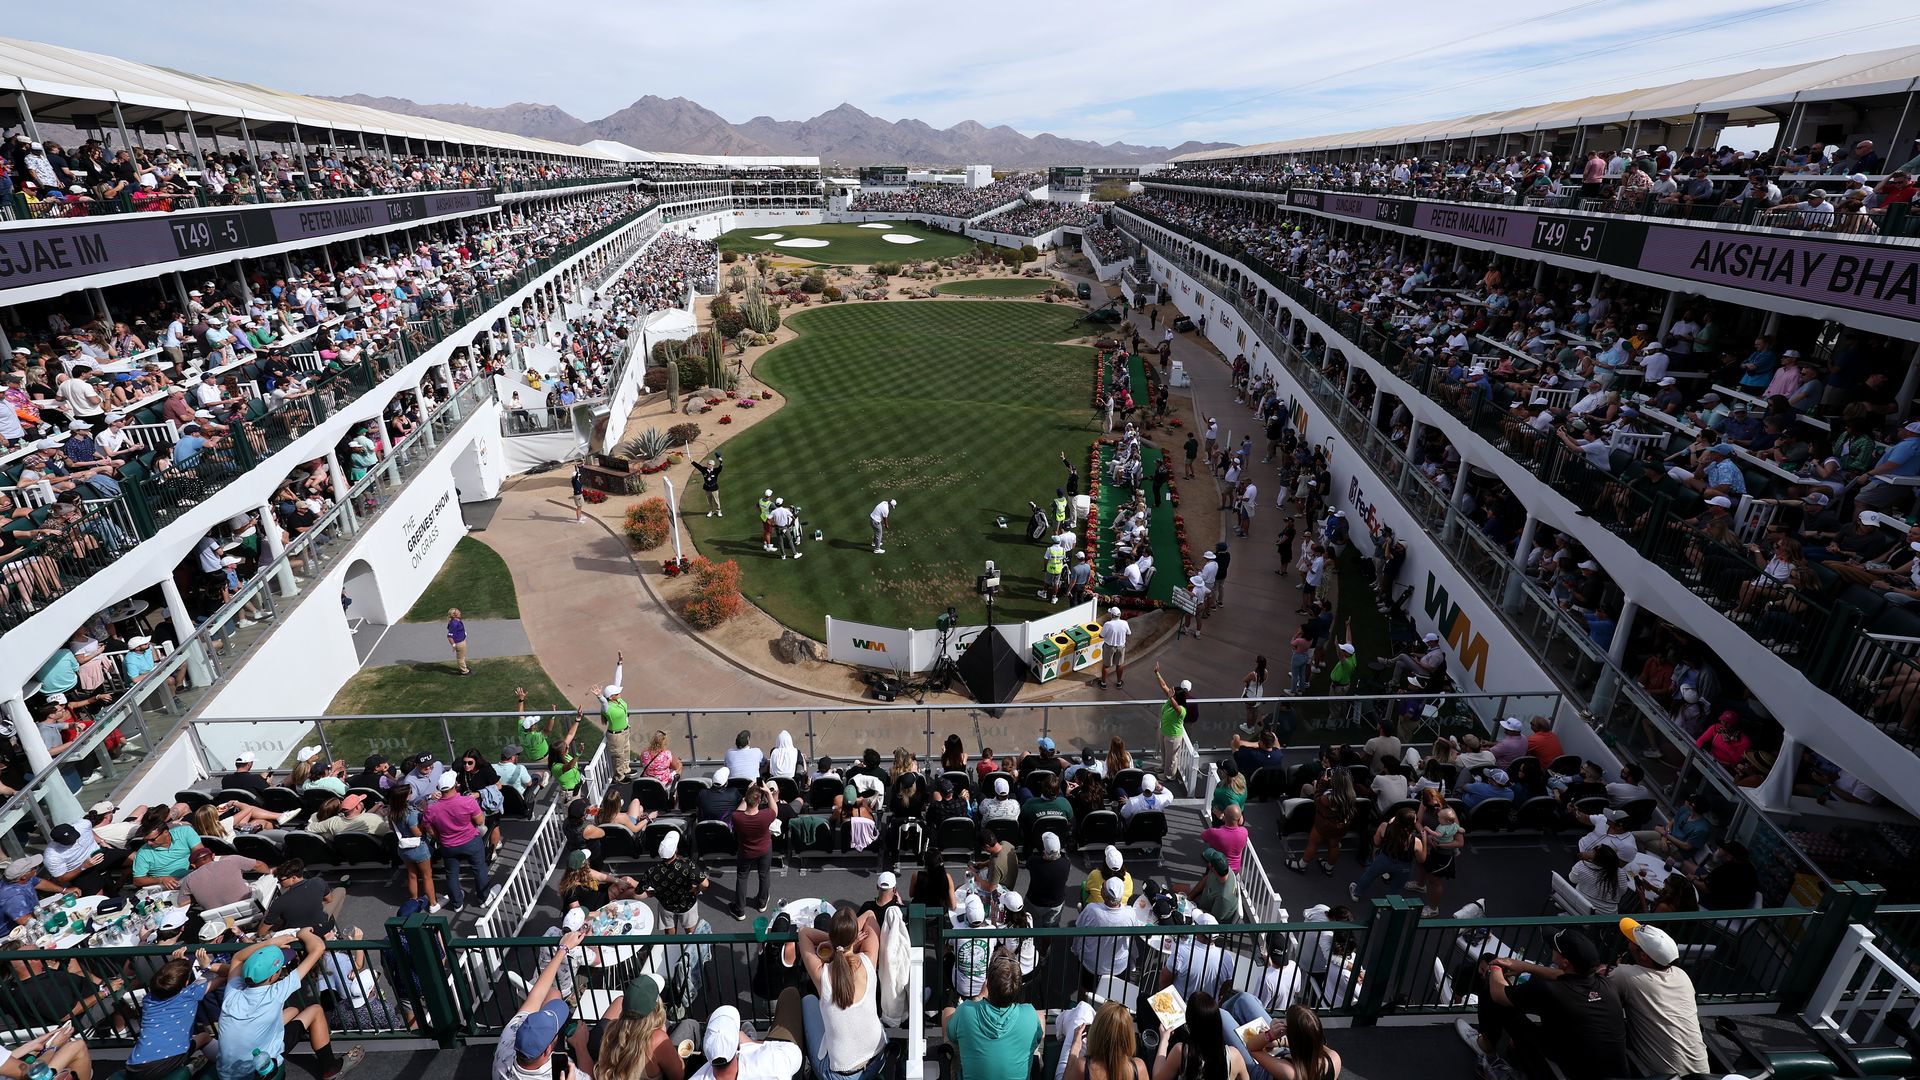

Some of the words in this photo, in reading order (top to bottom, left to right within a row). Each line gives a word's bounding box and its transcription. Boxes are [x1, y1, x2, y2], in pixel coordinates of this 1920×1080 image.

[299, 210, 334, 232] PETER
[333, 206, 374, 228] MALNATI
[387, 203, 402, 220] T49
[405, 201, 413, 217] -5
[1377, 203, 1389, 219] T49
[1430, 208, 1458, 229] PETER
[1458, 212, 1508, 238] MALNATI
[72, 233, 109, 266] IM
[173, 222, 210, 250] T49
[221, 219, 238, 243] -5
[1537, 221, 1565, 247] T49
[1574, 226, 1595, 252] -5
[1689, 239, 1828, 288] AKSHAY
[1827, 254, 1920, 305] BHA
[1289, 393, 1309, 440] WM
[402, 514, 416, 537] THE
[407, 508, 435, 553] GREENEST
[434, 489, 450, 516] SHOW
[1355, 487, 1381, 537] FedEx
[411, 549, 422, 569] ON
[420, 525, 440, 556] GRASS
[852, 637, 887, 652] WM
[1424, 569, 1490, 692] WM
